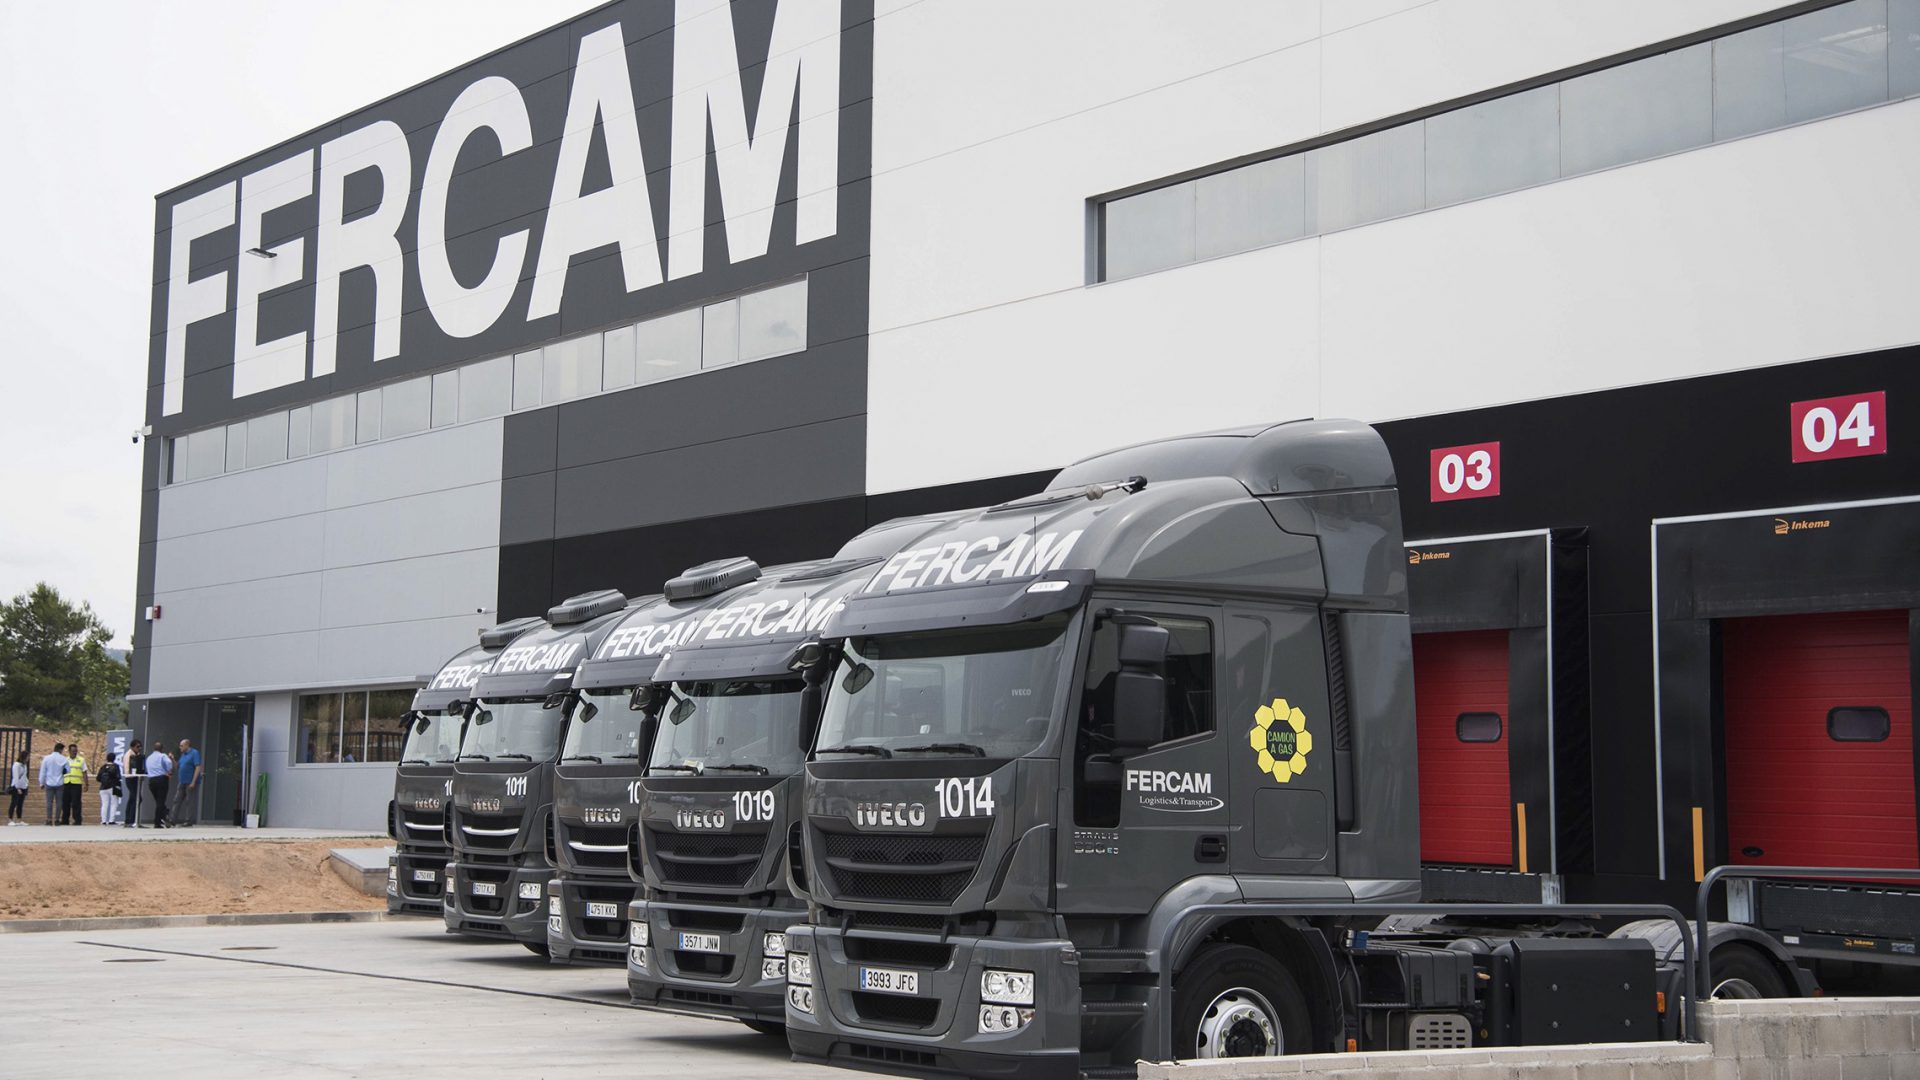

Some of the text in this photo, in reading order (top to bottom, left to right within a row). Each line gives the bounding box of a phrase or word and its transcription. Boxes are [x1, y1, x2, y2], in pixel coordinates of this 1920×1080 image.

[162, 0, 841, 416] FERCAM
[1801, 401, 1875, 453] 04
[1438, 450, 1492, 494] 03
[1792, 520, 1830, 530] Inkema
[865, 529, 1084, 594] FERCAM
[1422, 552, 1450, 560] Inkema
[688, 598, 843, 644] FERCAM
[493, 643, 580, 673] FERCAM
[1011, 688, 1032, 697] IVECO
[1268, 731, 1295, 743] CAMION
[1271, 743, 1293, 755] A GAS
[505, 776, 527, 796] 1011
[1126, 769, 1212, 794] FERCAM
[415, 798, 440, 809] IVECO
[473, 798, 500, 812] IVECO
[732, 789, 775, 821] 1019
[934, 776, 995, 818] 1014
[1139, 795, 1213, 807] Logistics&Transport
[584, 807, 621, 823] IVECO
[676, 810, 725, 828] IVECO
[857, 802, 926, 827] IVECO
[591, 904, 604, 916] 4751
[684, 935, 718, 951] 3571 JNW
[867, 970, 915, 992] 3993 JFC
